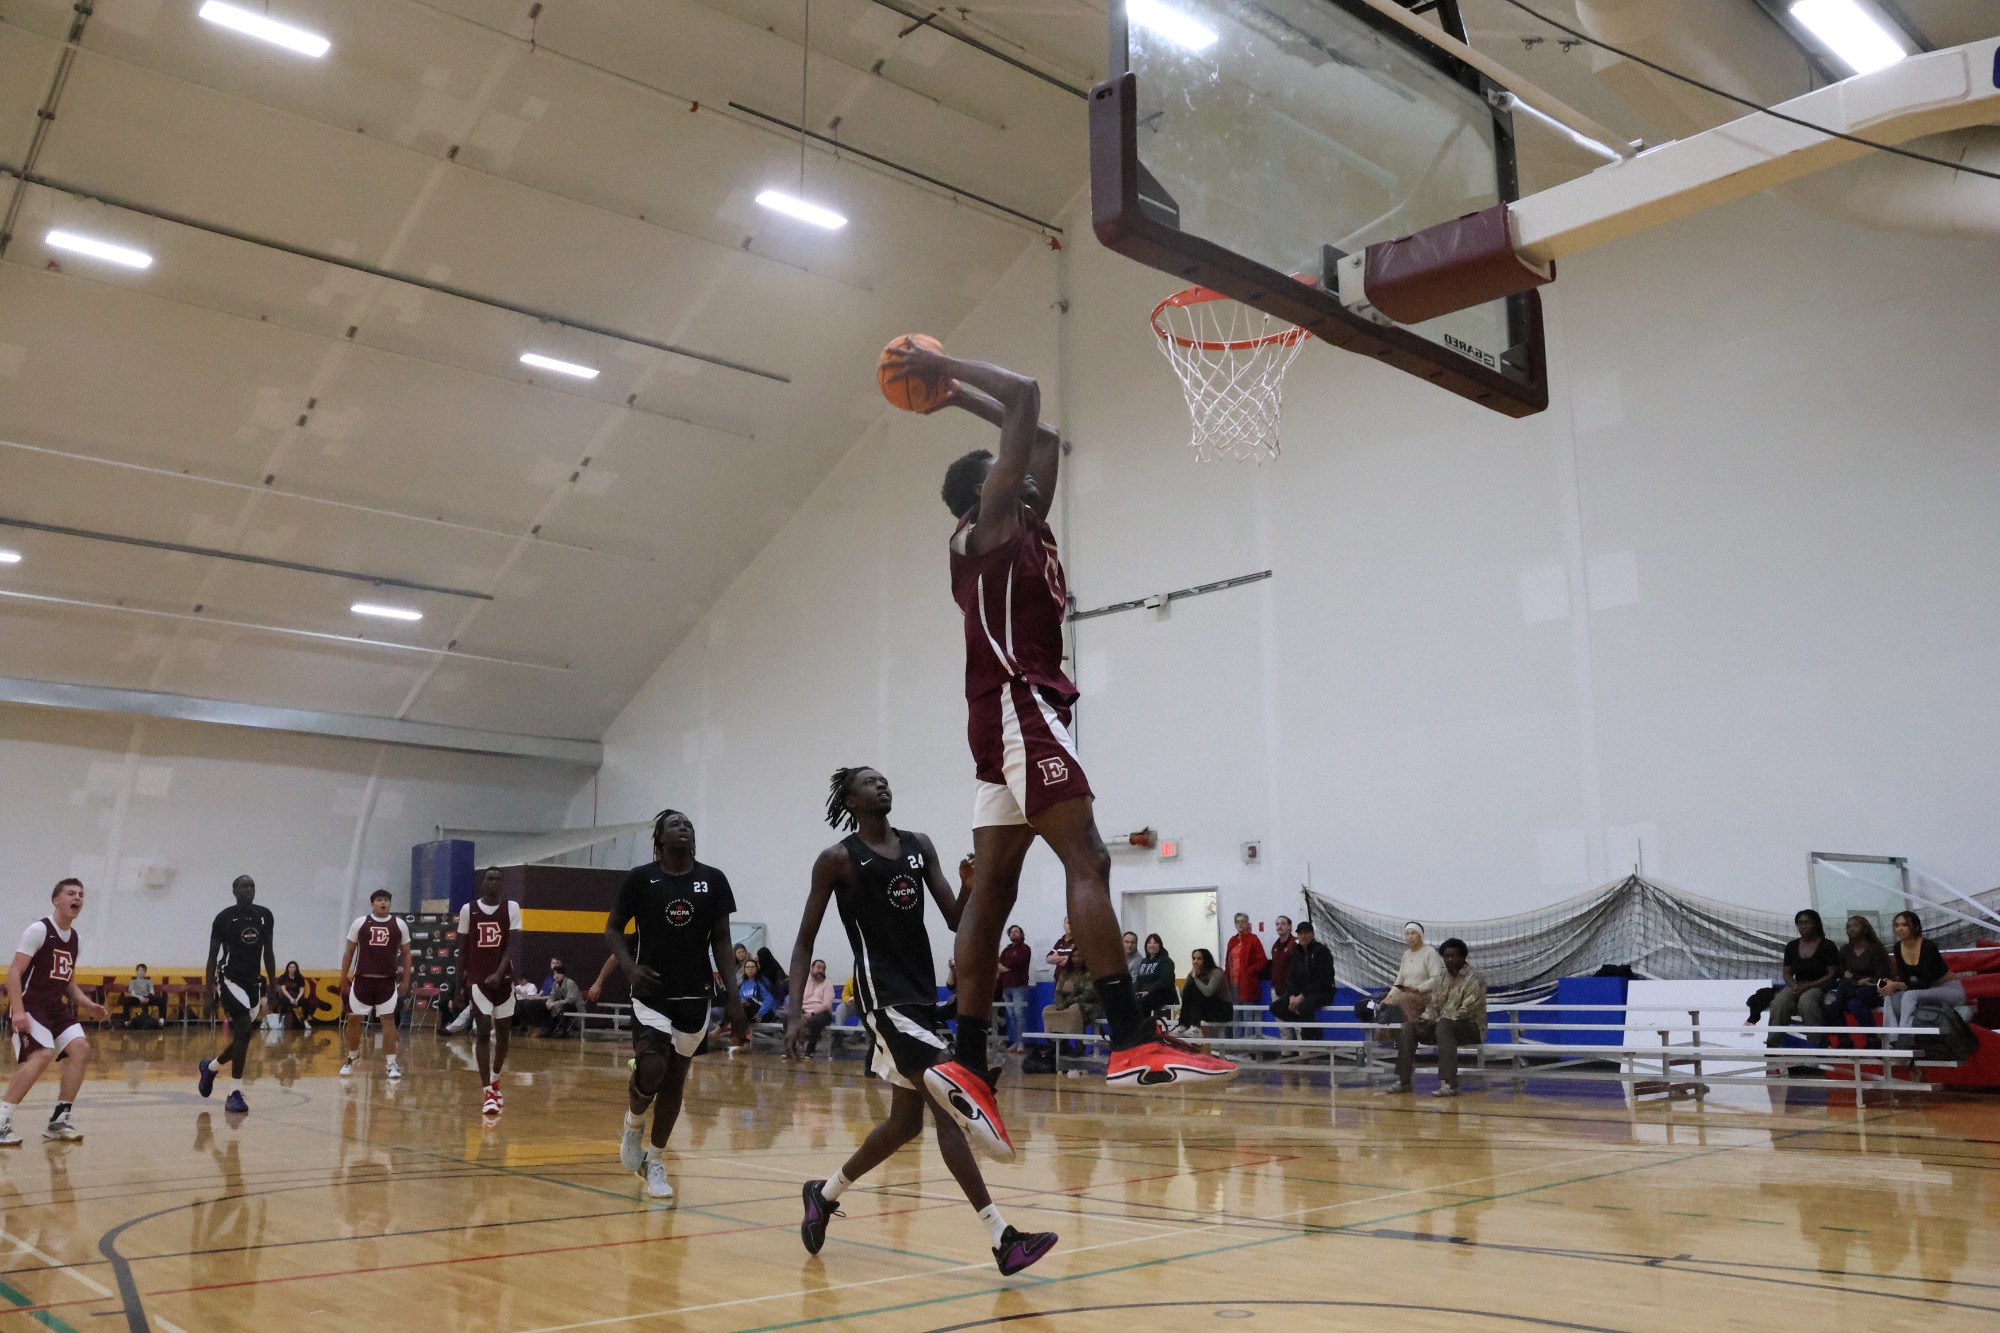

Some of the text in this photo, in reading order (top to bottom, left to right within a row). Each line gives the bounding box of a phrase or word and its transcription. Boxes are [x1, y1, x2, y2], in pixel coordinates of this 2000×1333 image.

[1037, 756, 1069, 786] E
[907, 853, 925, 869] 24
[693, 881, 708, 893] 23
[892, 887, 916, 897] WCPA
[369, 926, 390, 946] E
[477, 922, 502, 948] E
[50, 949, 73, 982] E
